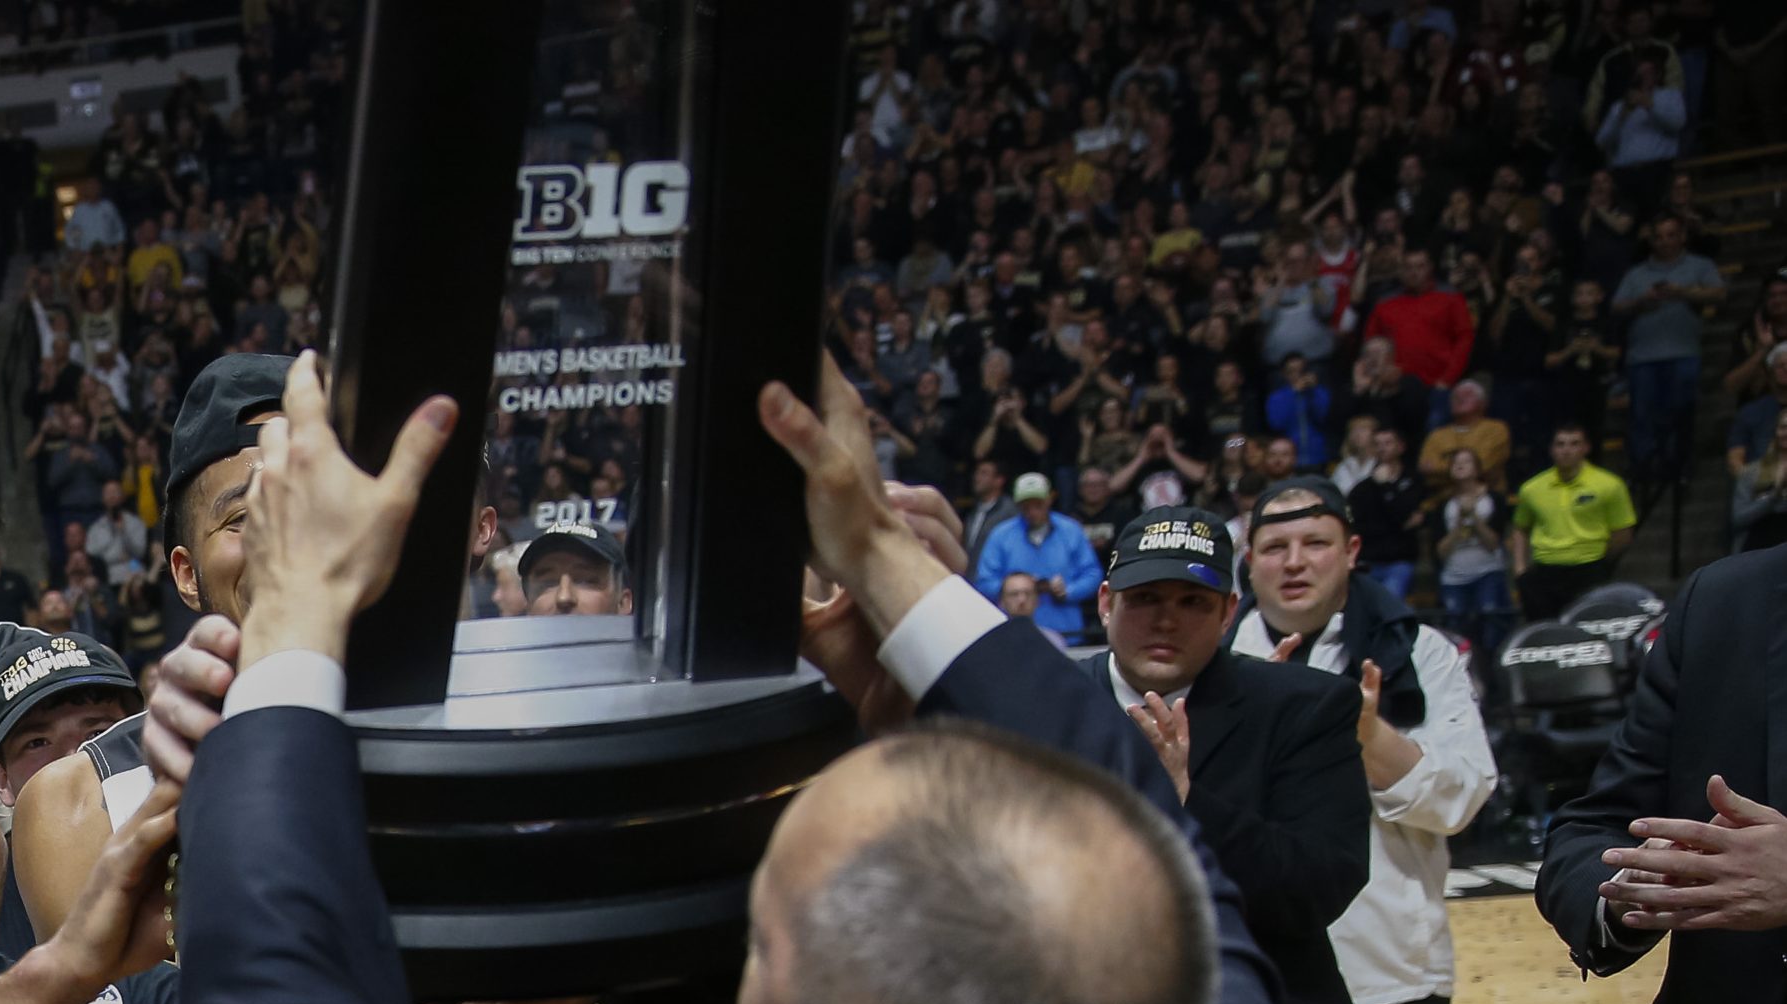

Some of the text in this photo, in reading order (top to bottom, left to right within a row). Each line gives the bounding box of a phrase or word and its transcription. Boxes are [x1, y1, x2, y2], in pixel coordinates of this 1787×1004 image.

[494, 343, 686, 377] MEN'S BASKETBALL
[499, 379, 675, 413] CHAMPIONS
[535, 498, 617, 529] 2017
[1138, 533, 1214, 556] CHAMPIONS
[3, 649, 91, 701] CHAMPIONS
